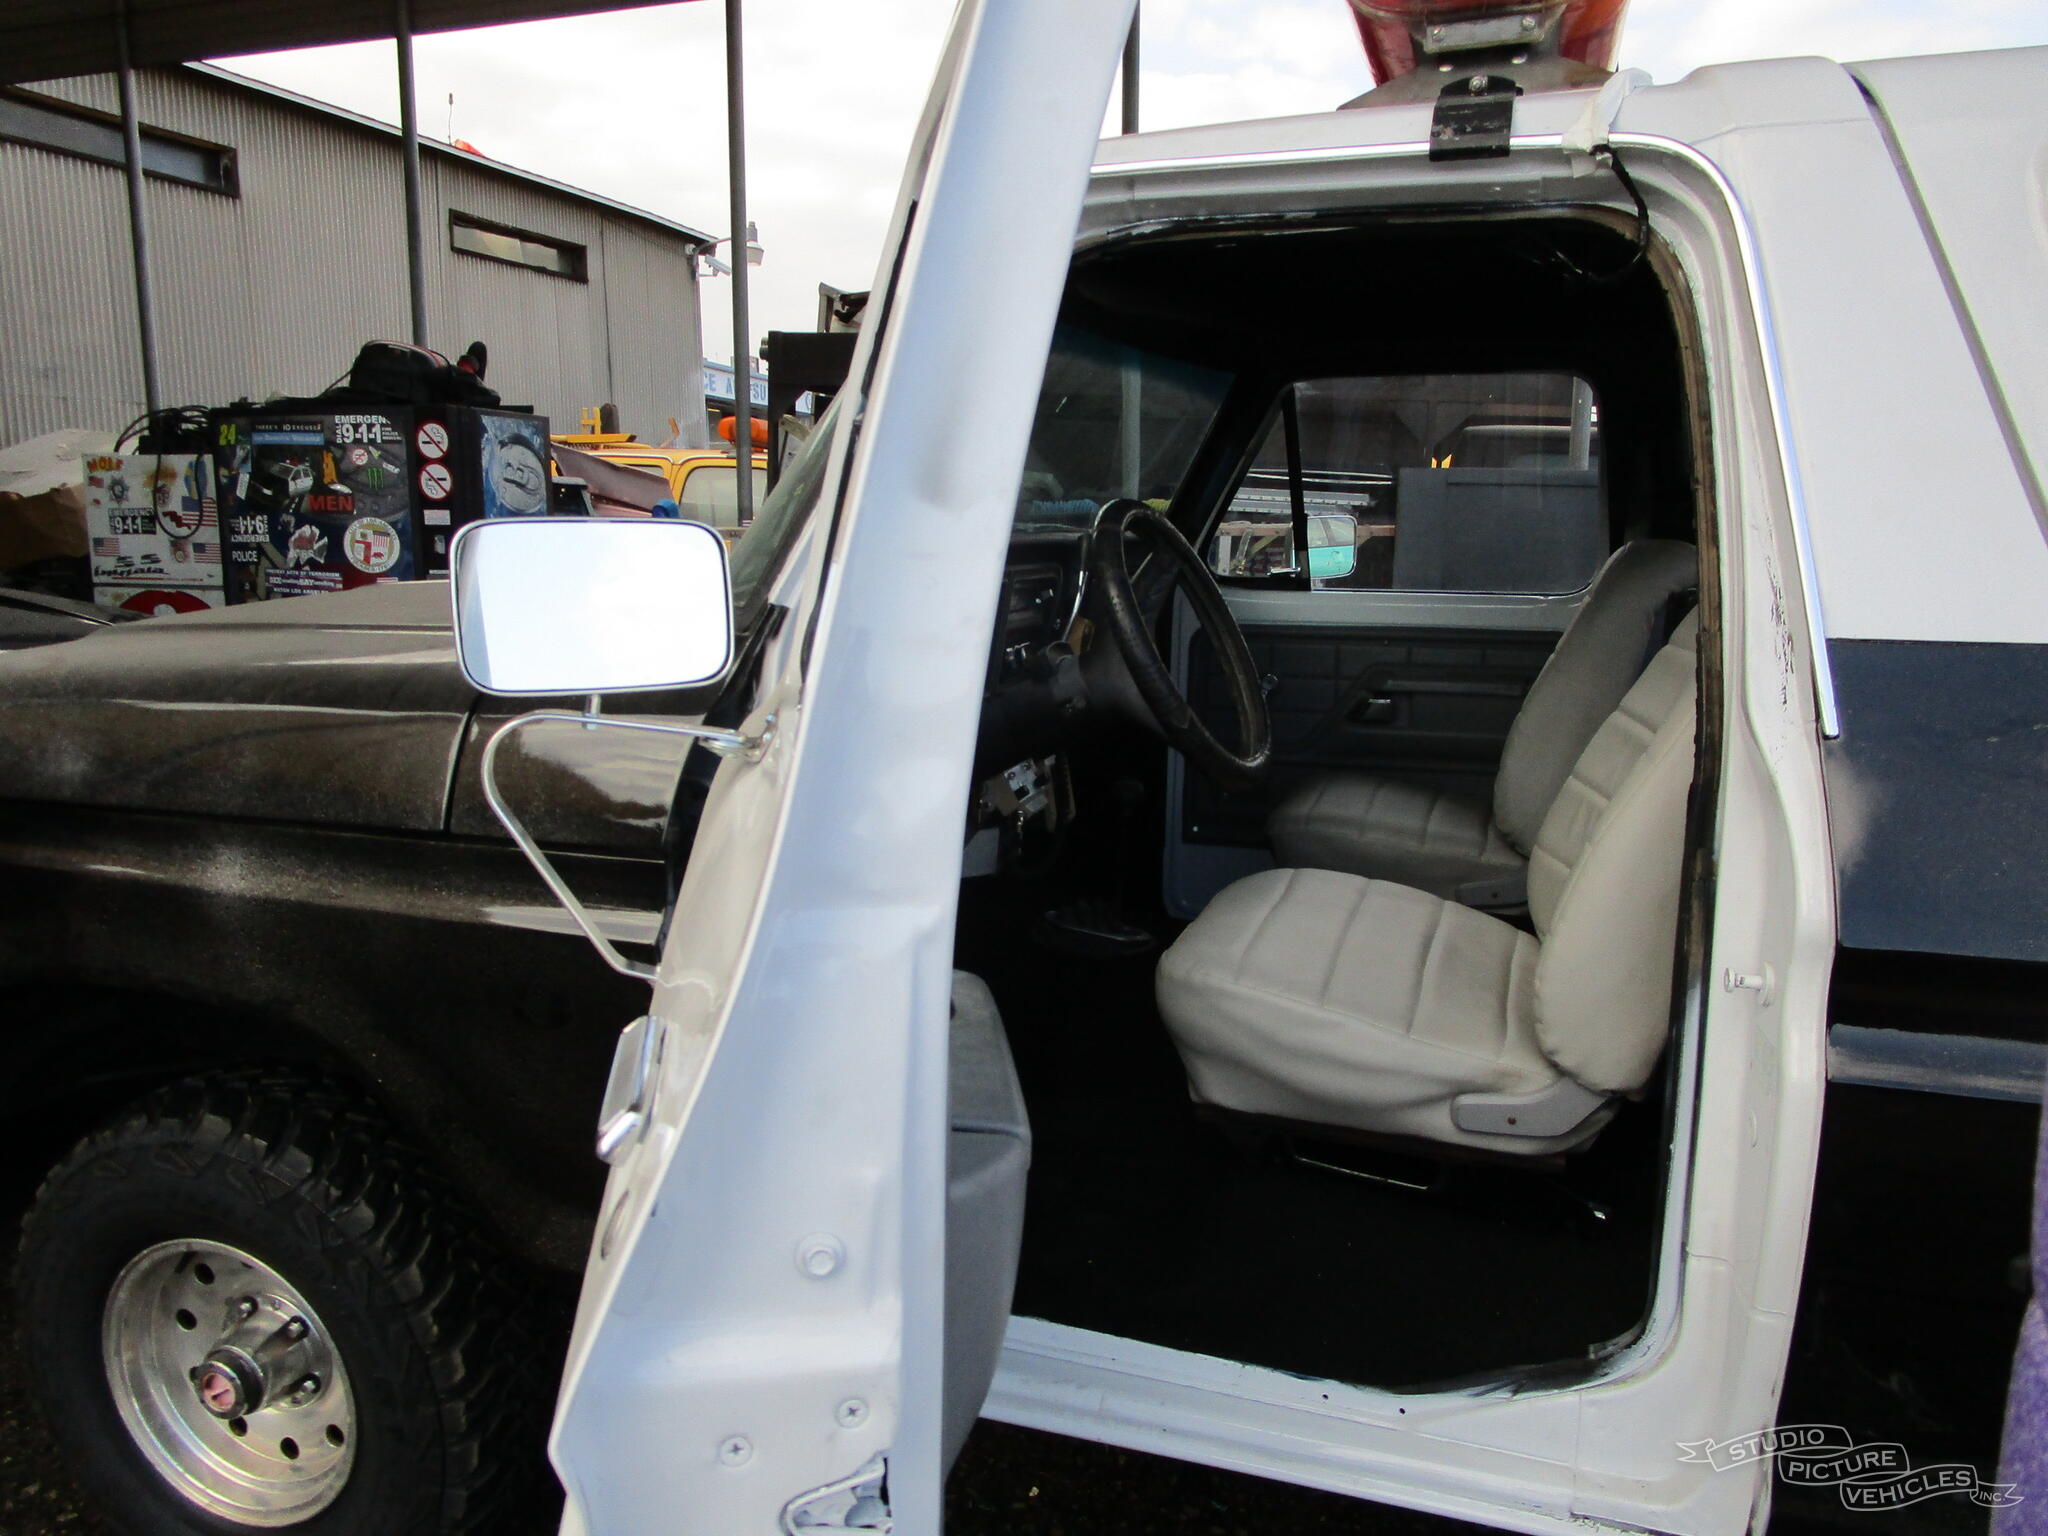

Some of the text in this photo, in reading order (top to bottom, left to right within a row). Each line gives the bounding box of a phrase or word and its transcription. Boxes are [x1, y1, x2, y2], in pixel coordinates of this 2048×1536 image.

[219, 424, 237, 446] 24
[342, 423, 381, 443] 9-1-1
[308, 495, 353, 511] MEN
[114, 517, 142, 534] 9-1-1
[232, 550, 258, 562] POLICE
